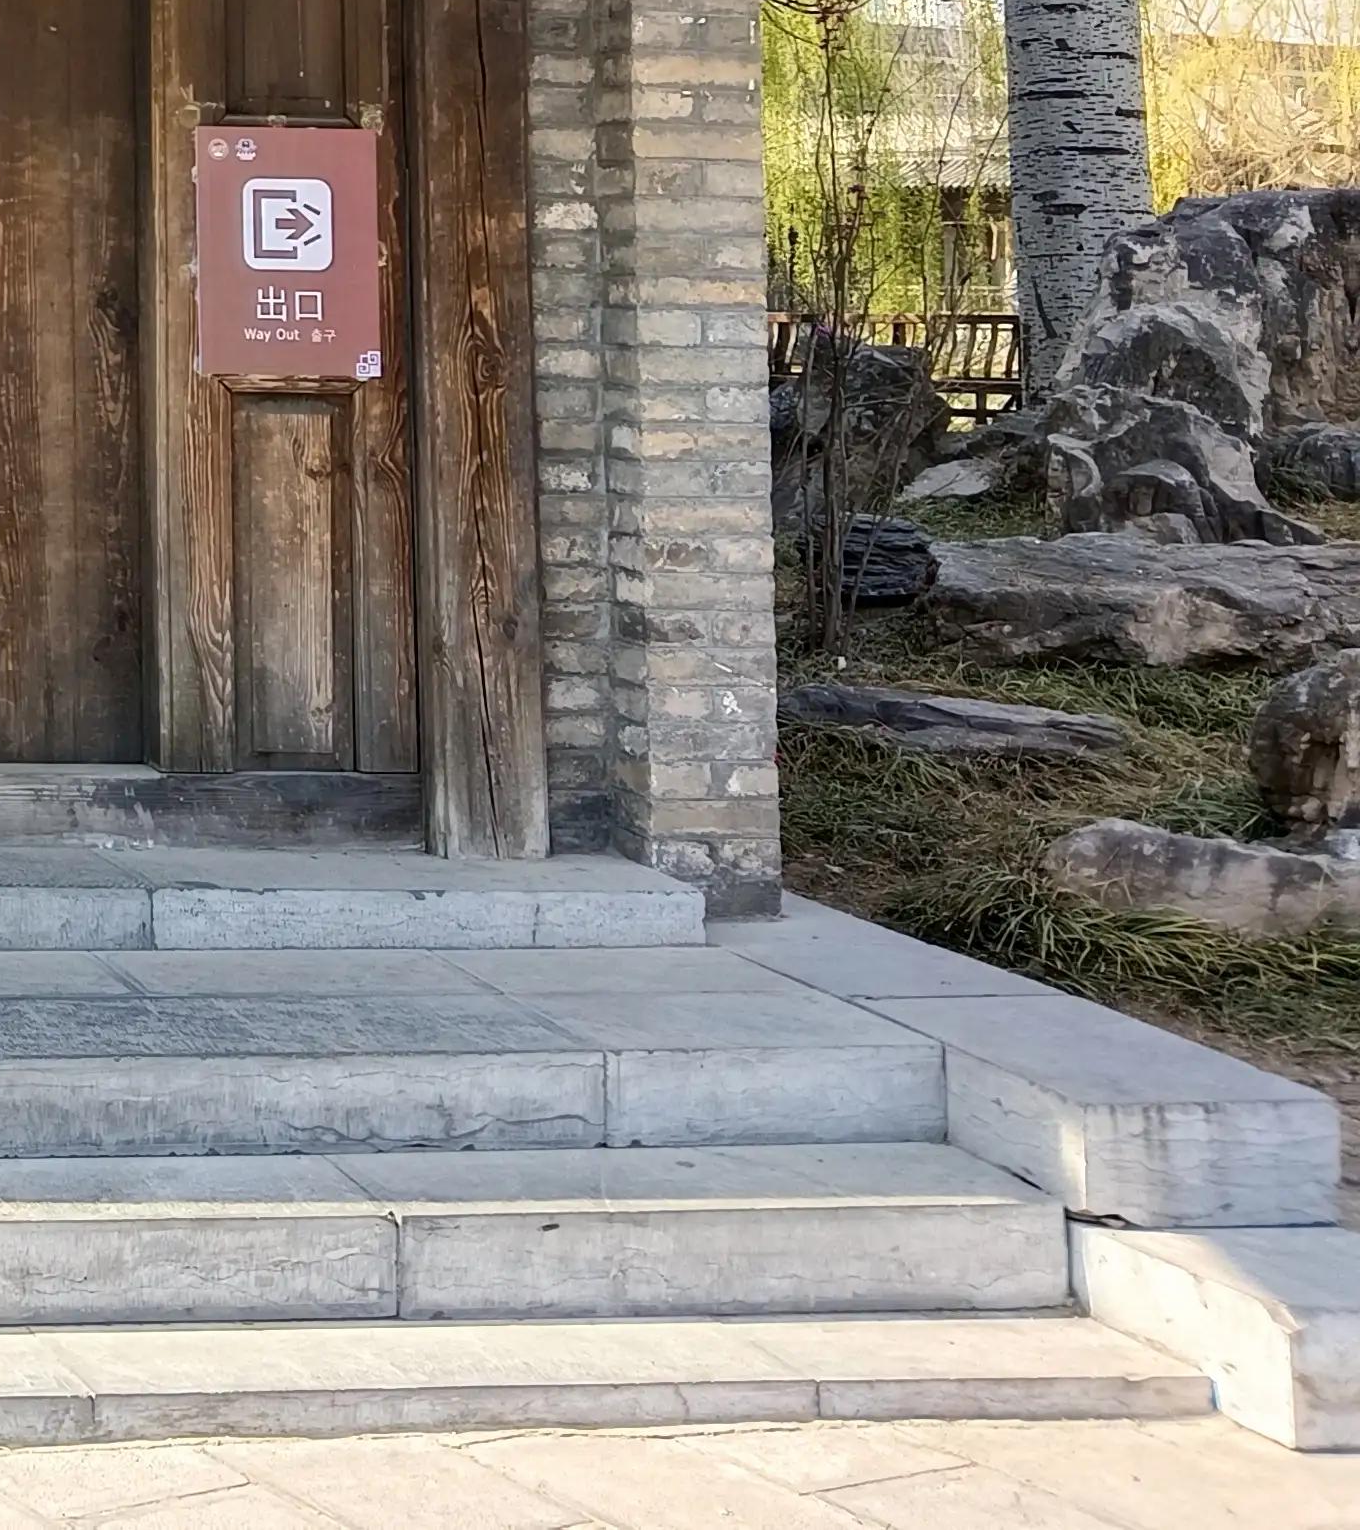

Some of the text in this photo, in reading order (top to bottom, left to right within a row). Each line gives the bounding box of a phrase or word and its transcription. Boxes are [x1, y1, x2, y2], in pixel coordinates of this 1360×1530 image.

[256, 285, 323, 322] 出口
[244, 328, 301, 342] Way Out
[311, 329, 337, 343] 출구
